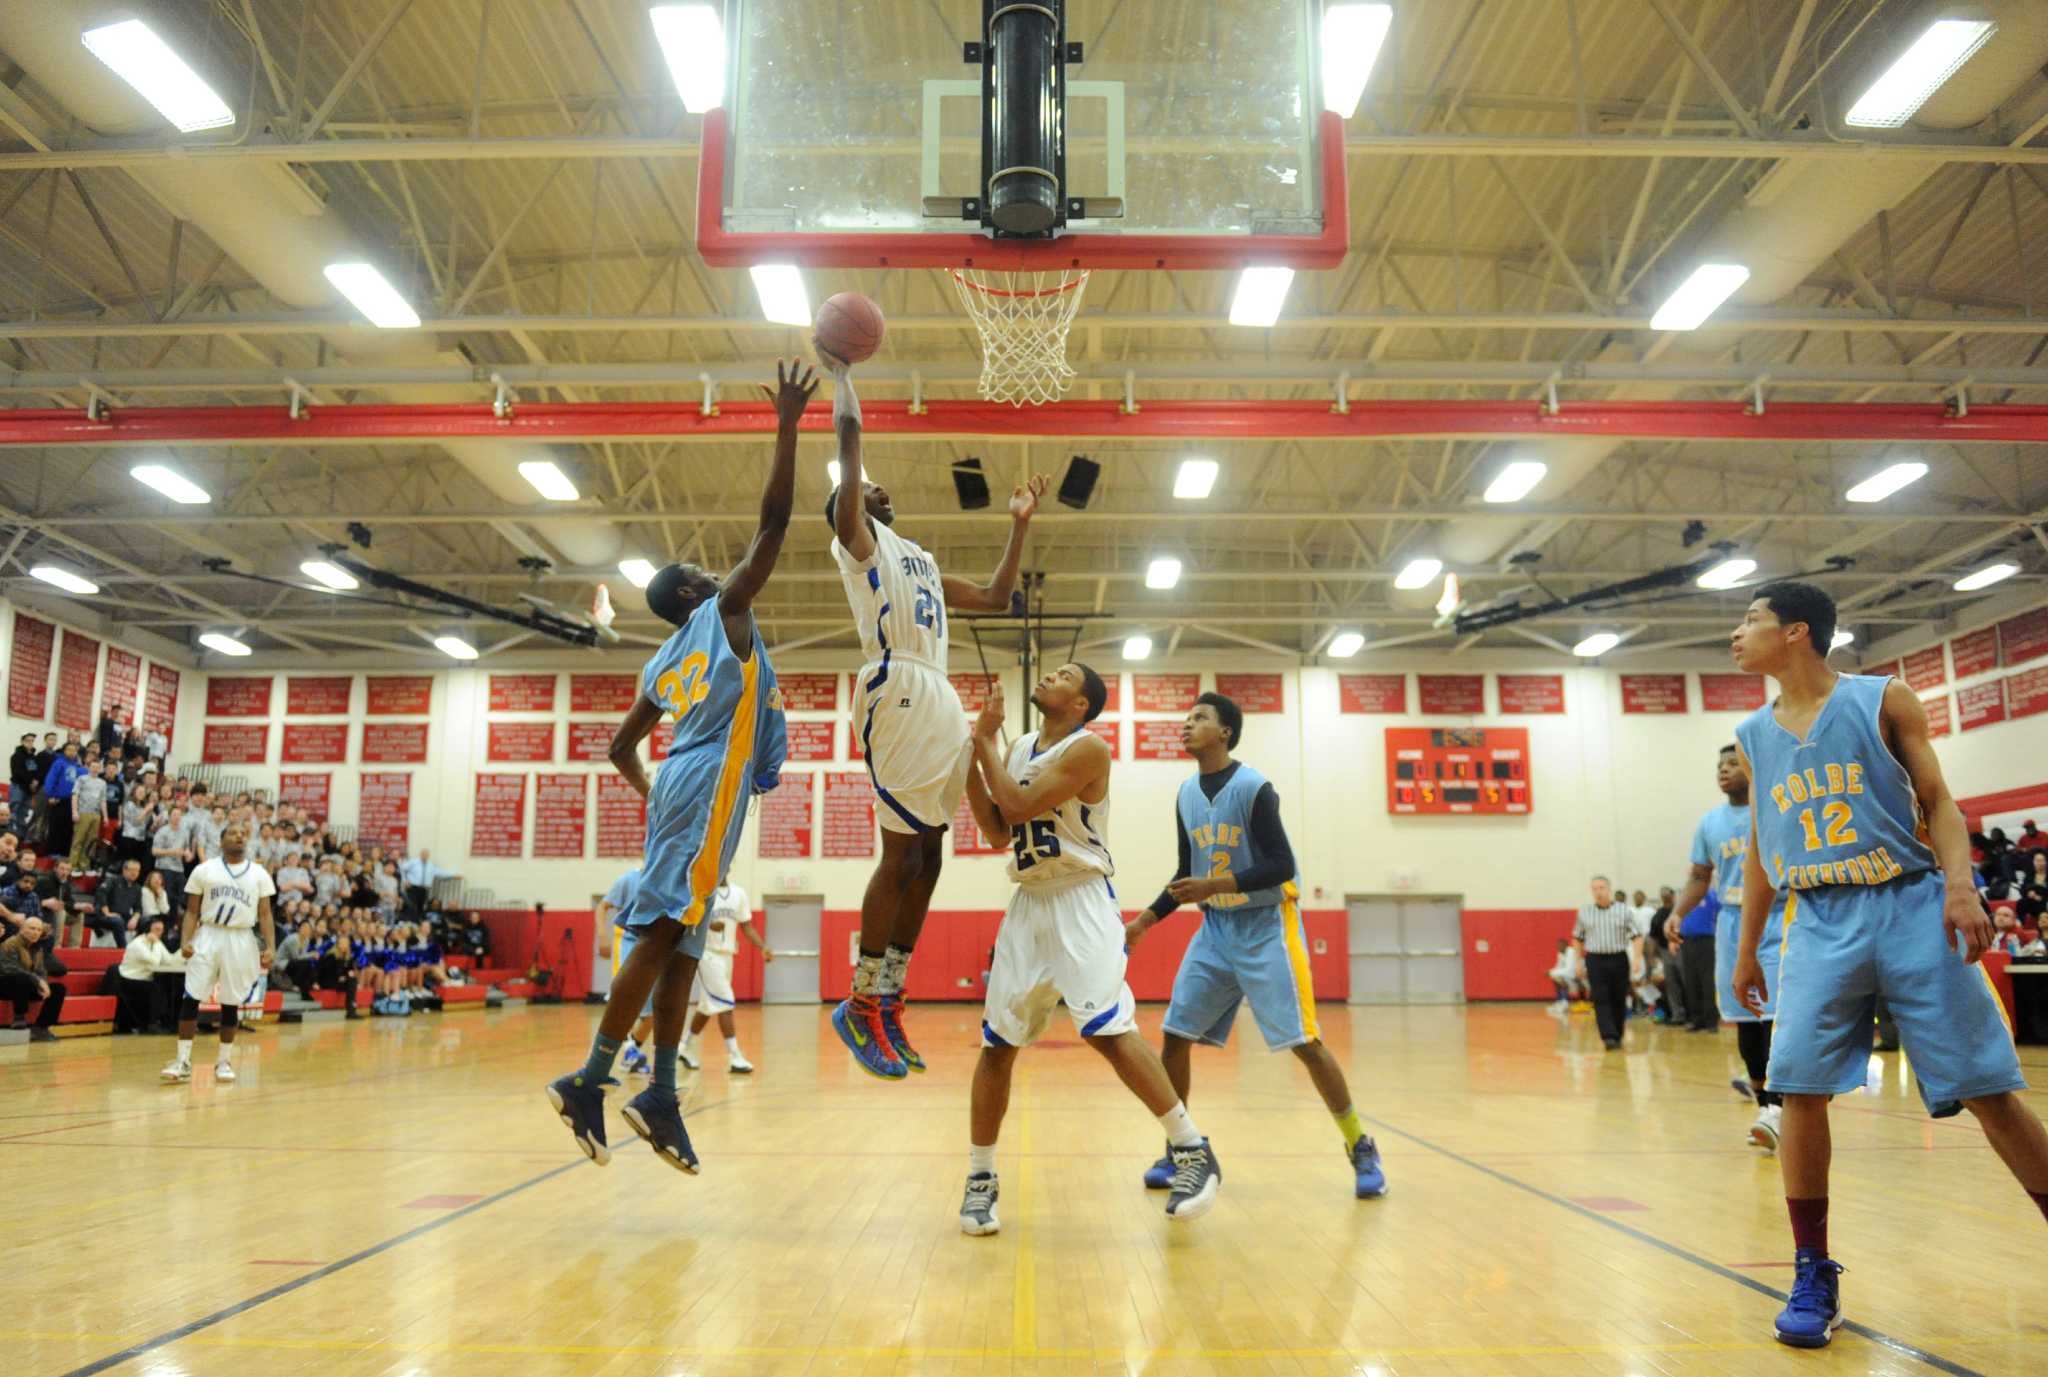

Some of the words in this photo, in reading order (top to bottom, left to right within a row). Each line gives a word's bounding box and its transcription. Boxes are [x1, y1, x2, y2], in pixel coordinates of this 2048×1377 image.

[915, 584, 942, 639] 21
[656, 651, 711, 721] 32
[1771, 763, 1863, 814] KOLBE
[1012, 820, 1061, 871] 25
[1799, 801, 1858, 851] 12
[1211, 851, 1233, 878] 2
[214, 903, 236, 926] 11
